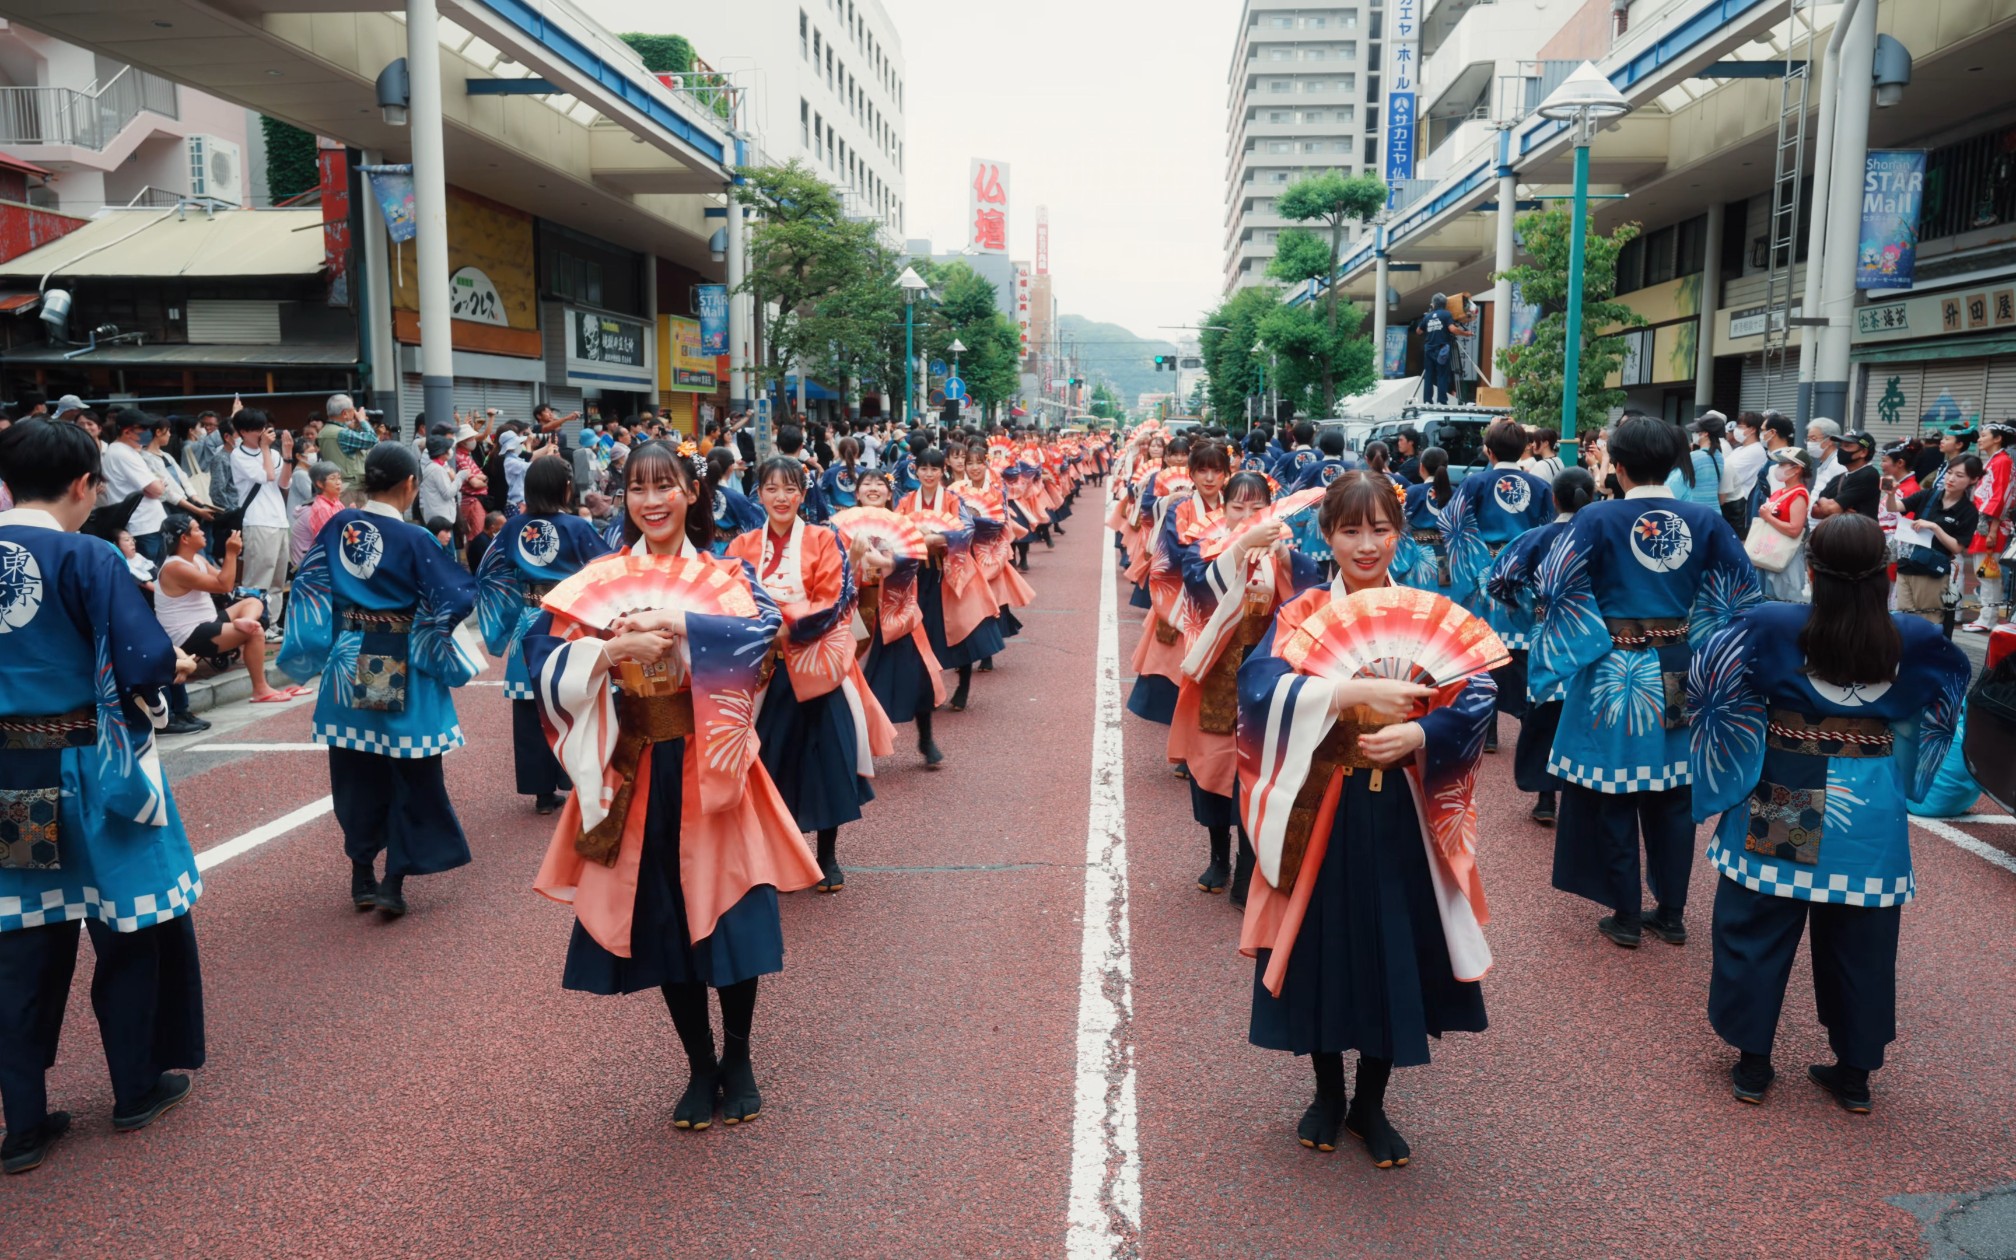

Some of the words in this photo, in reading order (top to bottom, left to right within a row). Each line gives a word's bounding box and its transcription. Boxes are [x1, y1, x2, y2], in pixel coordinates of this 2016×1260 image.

[1866, 158, 1910, 170] Shonan
[1865, 171, 1923, 192] STAR
[973, 163, 1006, 250] 仏壇
[1863, 193, 1911, 213] Mall
[699, 296, 728, 306] STAR
[700, 307, 725, 317] Mall
